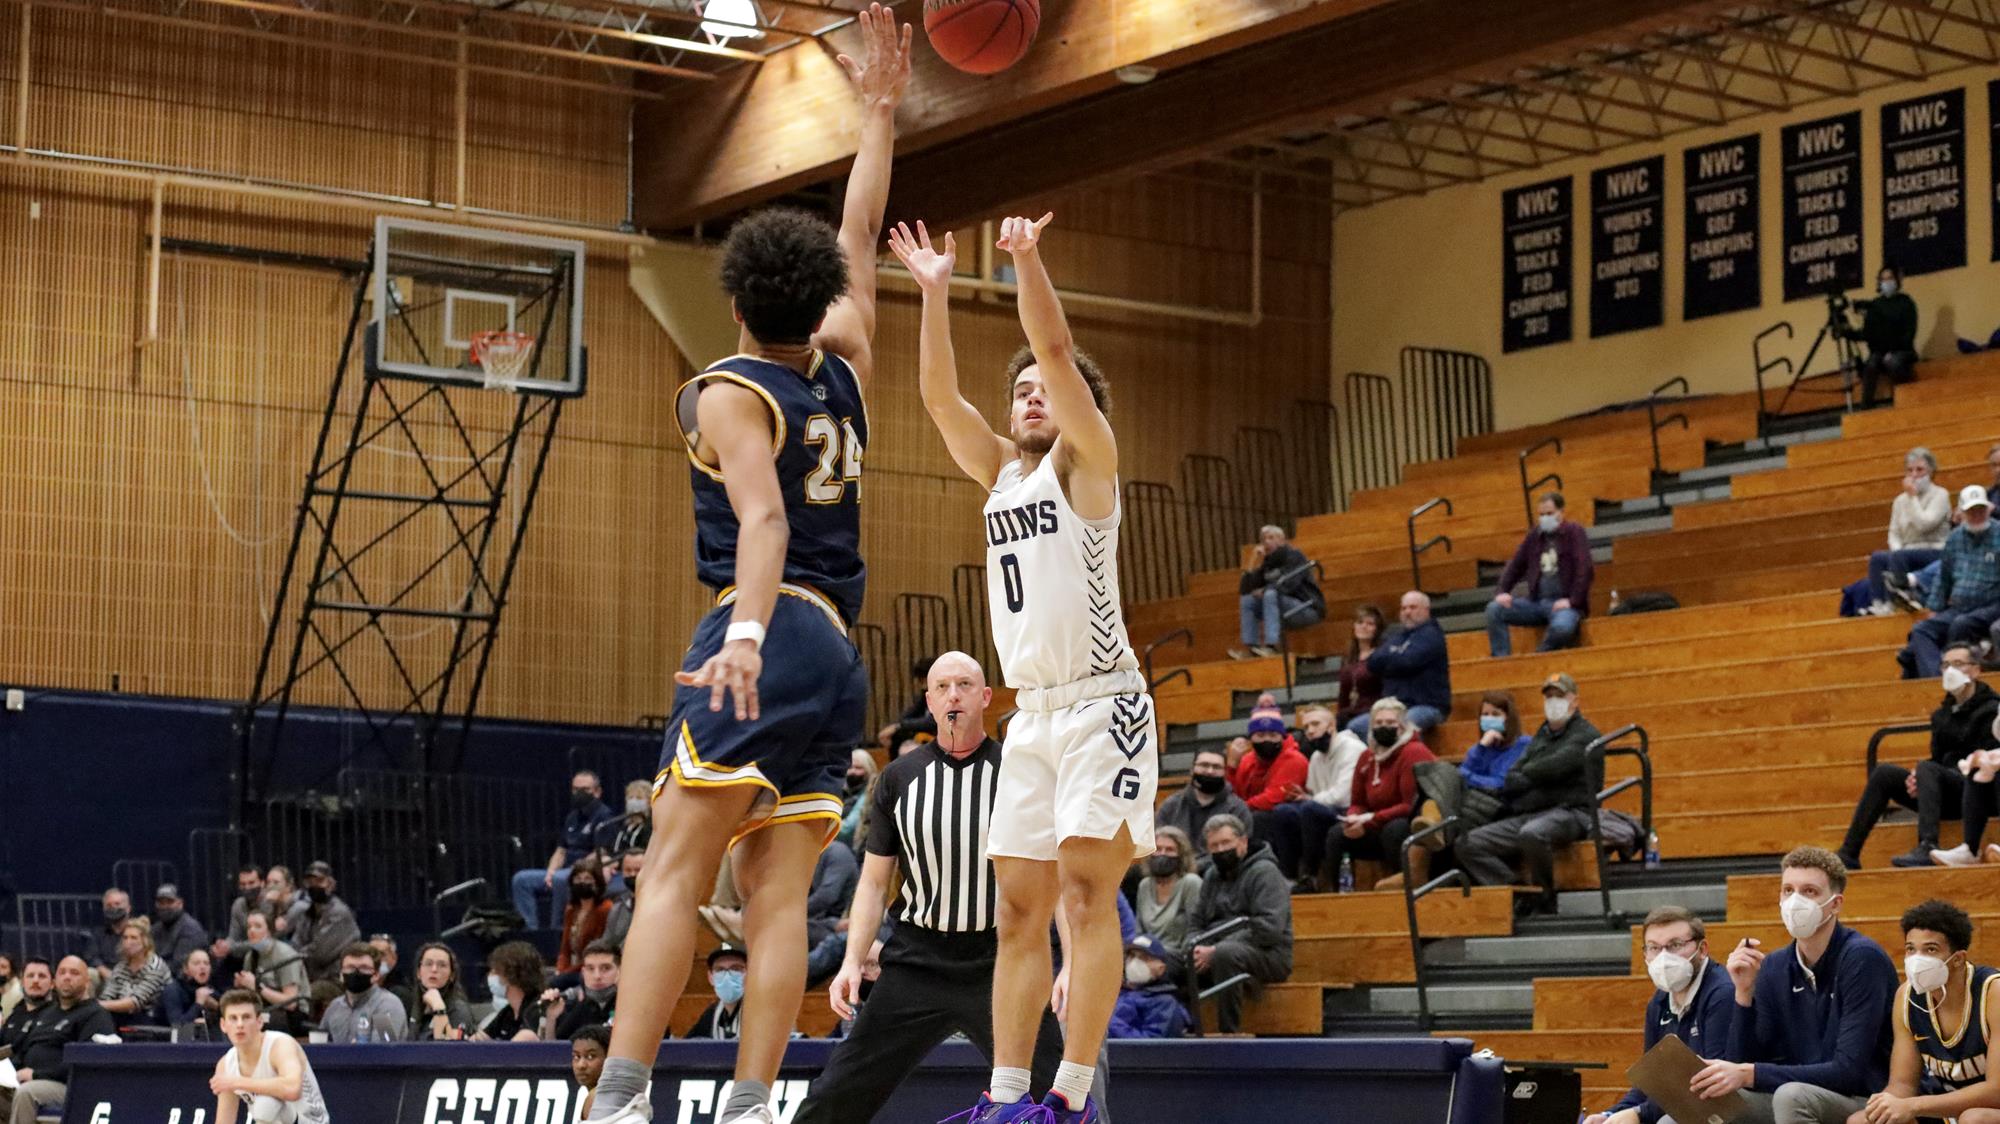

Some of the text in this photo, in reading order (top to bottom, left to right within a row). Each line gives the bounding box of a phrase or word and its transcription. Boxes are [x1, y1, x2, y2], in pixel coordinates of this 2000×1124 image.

[1900, 100, 1947, 134] NWC
[1798, 122, 1845, 157] NWC
[1699, 145, 1745, 179] NWC
[1894, 143, 1951, 172] WOMEN'S
[1606, 166, 1649, 198] NWC
[1795, 165, 1849, 193] WOMEN'S
[1886, 166, 1959, 197] BASKETBALL
[1517, 187, 1559, 219] NWC
[1695, 187, 1748, 214] WOMEN'S
[1798, 192, 1834, 216] TRACK
[1888, 189, 1959, 220] CHAMPIONS
[1706, 211, 1735, 235] GOLF
[1805, 214, 1839, 238] FIELD
[1908, 216, 1939, 240] 2015
[1690, 231, 1754, 262] CHAMPIONS
[1789, 234, 1858, 264] CHAMPIONS
[1597, 251, 1660, 280] CHAMPIONS
[1807, 261, 1836, 284] 2014
[1522, 273, 1553, 294] FIELD
[1509, 290, 1568, 319] CHAMPIONS
[804, 414, 863, 504] 24
[987, 500, 1058, 548] UINS
[1000, 553, 1024, 613] 0
